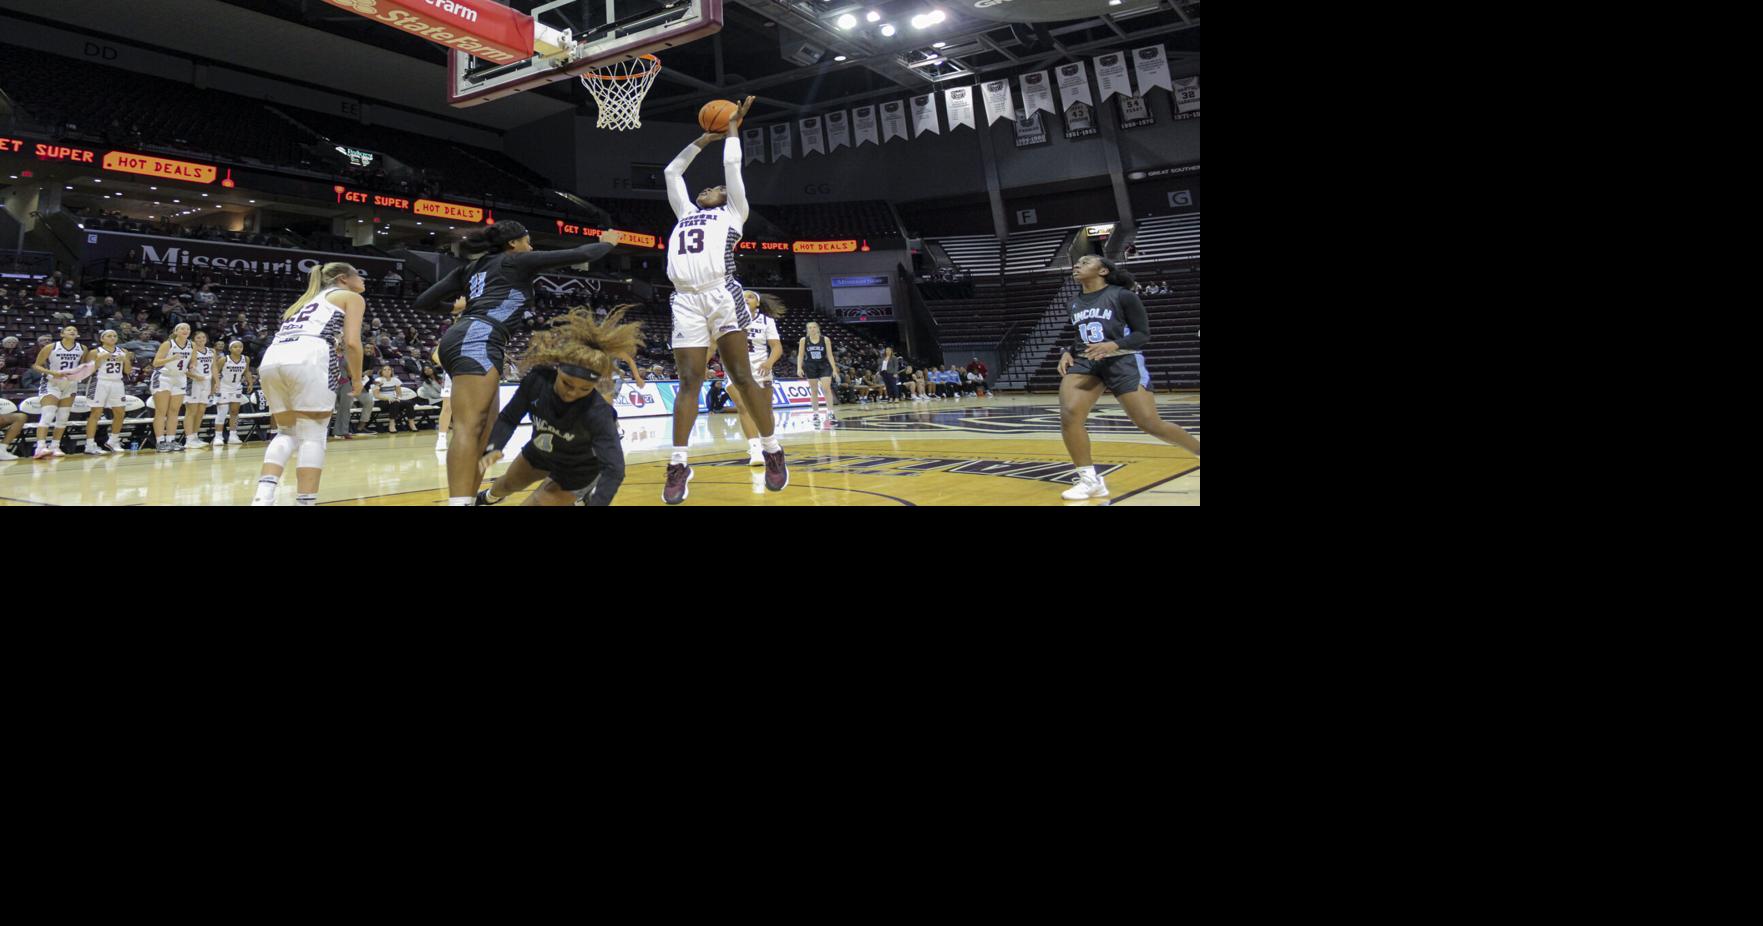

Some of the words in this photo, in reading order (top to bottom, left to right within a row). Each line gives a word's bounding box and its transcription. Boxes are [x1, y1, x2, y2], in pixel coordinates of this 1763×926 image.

[84, 42, 117, 60] DD
[35, 144, 94, 163] SUPER
[118, 157, 147, 170] HOT
[154, 162, 202, 178] DEALS
[804, 183, 831, 195] GG
[1172, 191, 1189, 205] G
[345, 192, 368, 203] GET
[374, 195, 409, 209] SUPER
[423, 204, 440, 213] HOT
[444, 207, 474, 218] DEALS
[1022, 211, 1031, 223] F
[679, 219, 707, 228] STATE
[564, 225, 579, 235] GET
[582, 227, 604, 238] SUPE
[678, 228, 705, 255] 13
[740, 241, 757, 250] GET
[761, 242, 789, 250] SUPER
[141, 244, 292, 274] Missouri
[1071, 308, 1112, 326] LINCOLN
[1078, 321, 1104, 344] 13
[60, 361, 74, 370] 21
[106, 362, 121, 374] 23
[177, 360, 184, 370] 4
[203, 363, 210, 374] 2
[231, 373, 237, 383] 1
